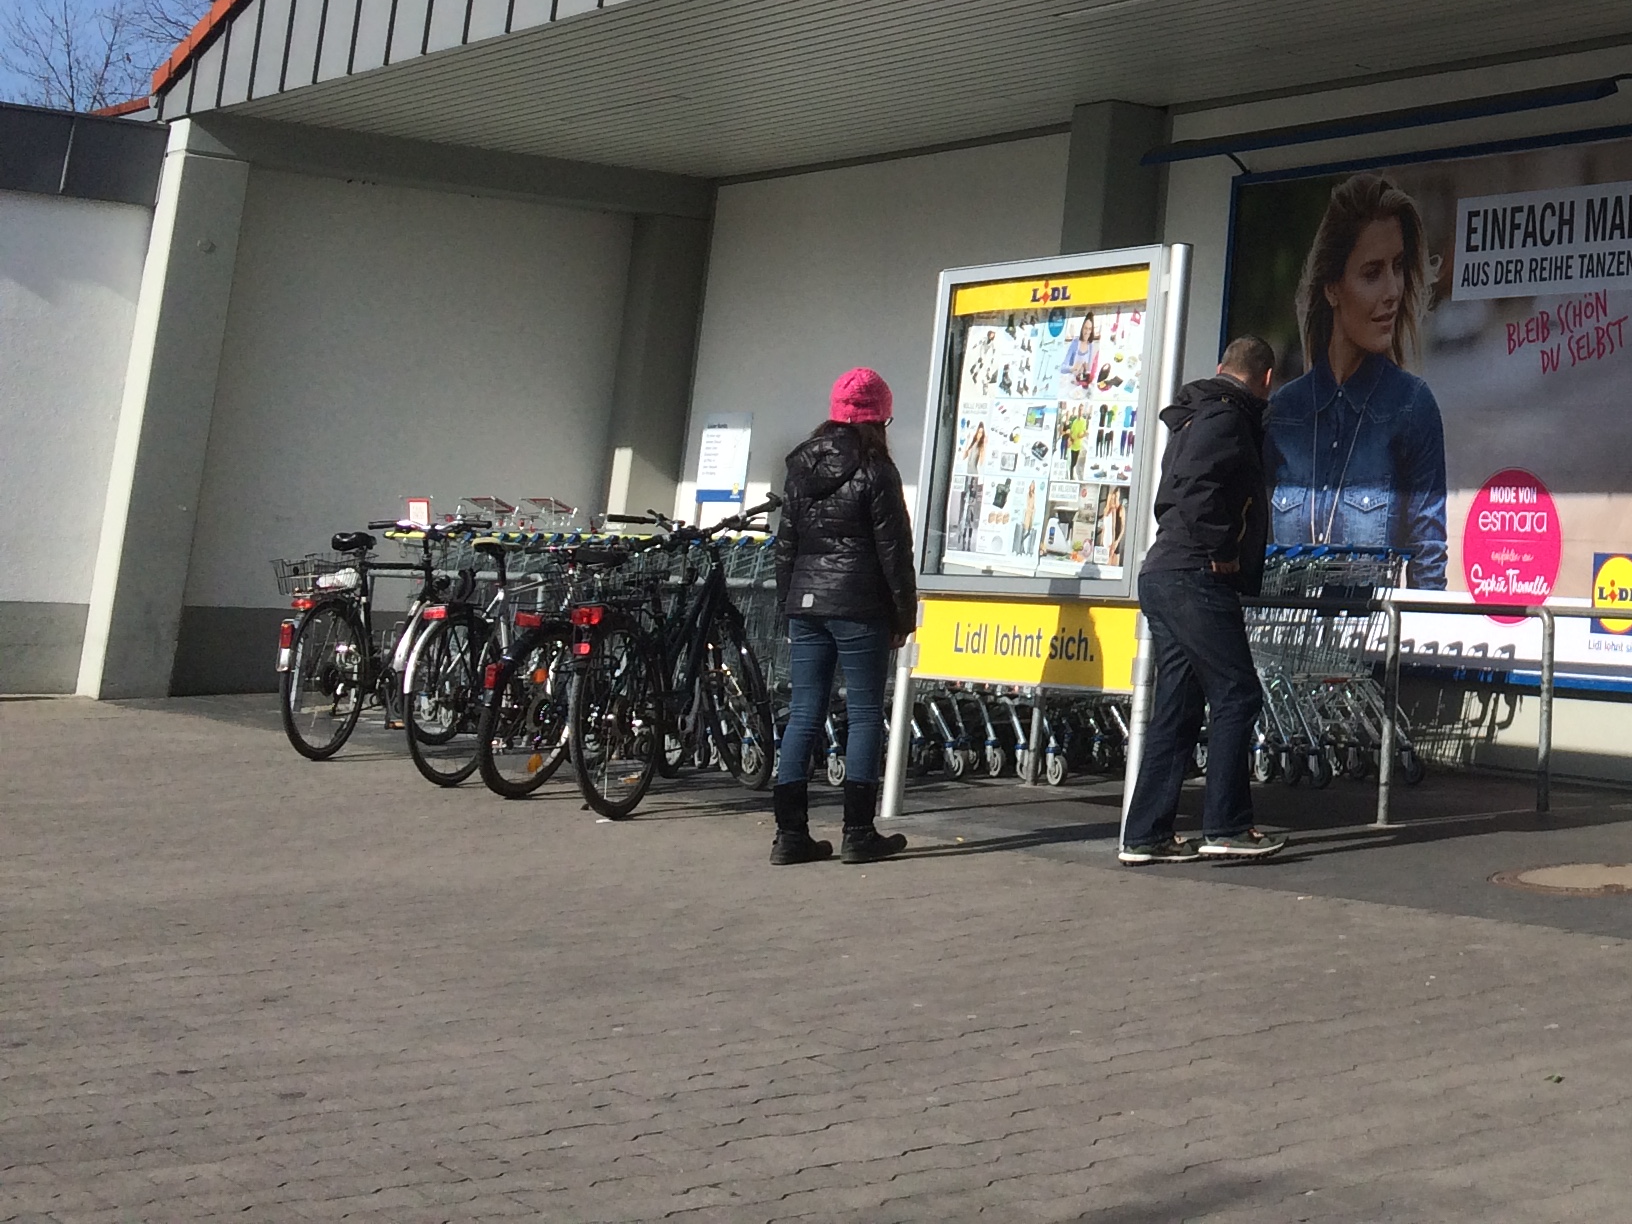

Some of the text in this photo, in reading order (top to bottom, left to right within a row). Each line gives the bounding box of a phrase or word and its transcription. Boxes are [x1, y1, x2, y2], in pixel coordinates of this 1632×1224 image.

[1465, 200, 1575, 253] EINFACH
[1461, 261, 1490, 288] AUS
[1493, 258, 1523, 285] DER
[1528, 255, 1574, 283] REIHE
[1506, 289, 1608, 355] BLEIB SCHÖN
[1540, 316, 1629, 375] DU SELBST
[1490, 486, 1537, 504] MODE VON
[1479, 511, 1547, 532] esmara
[954, 622, 1094, 661] Lidl lohnt sich.
[1588, 639, 1602, 651] Lidl
[1605, 640, 1624, 652] lohnt
